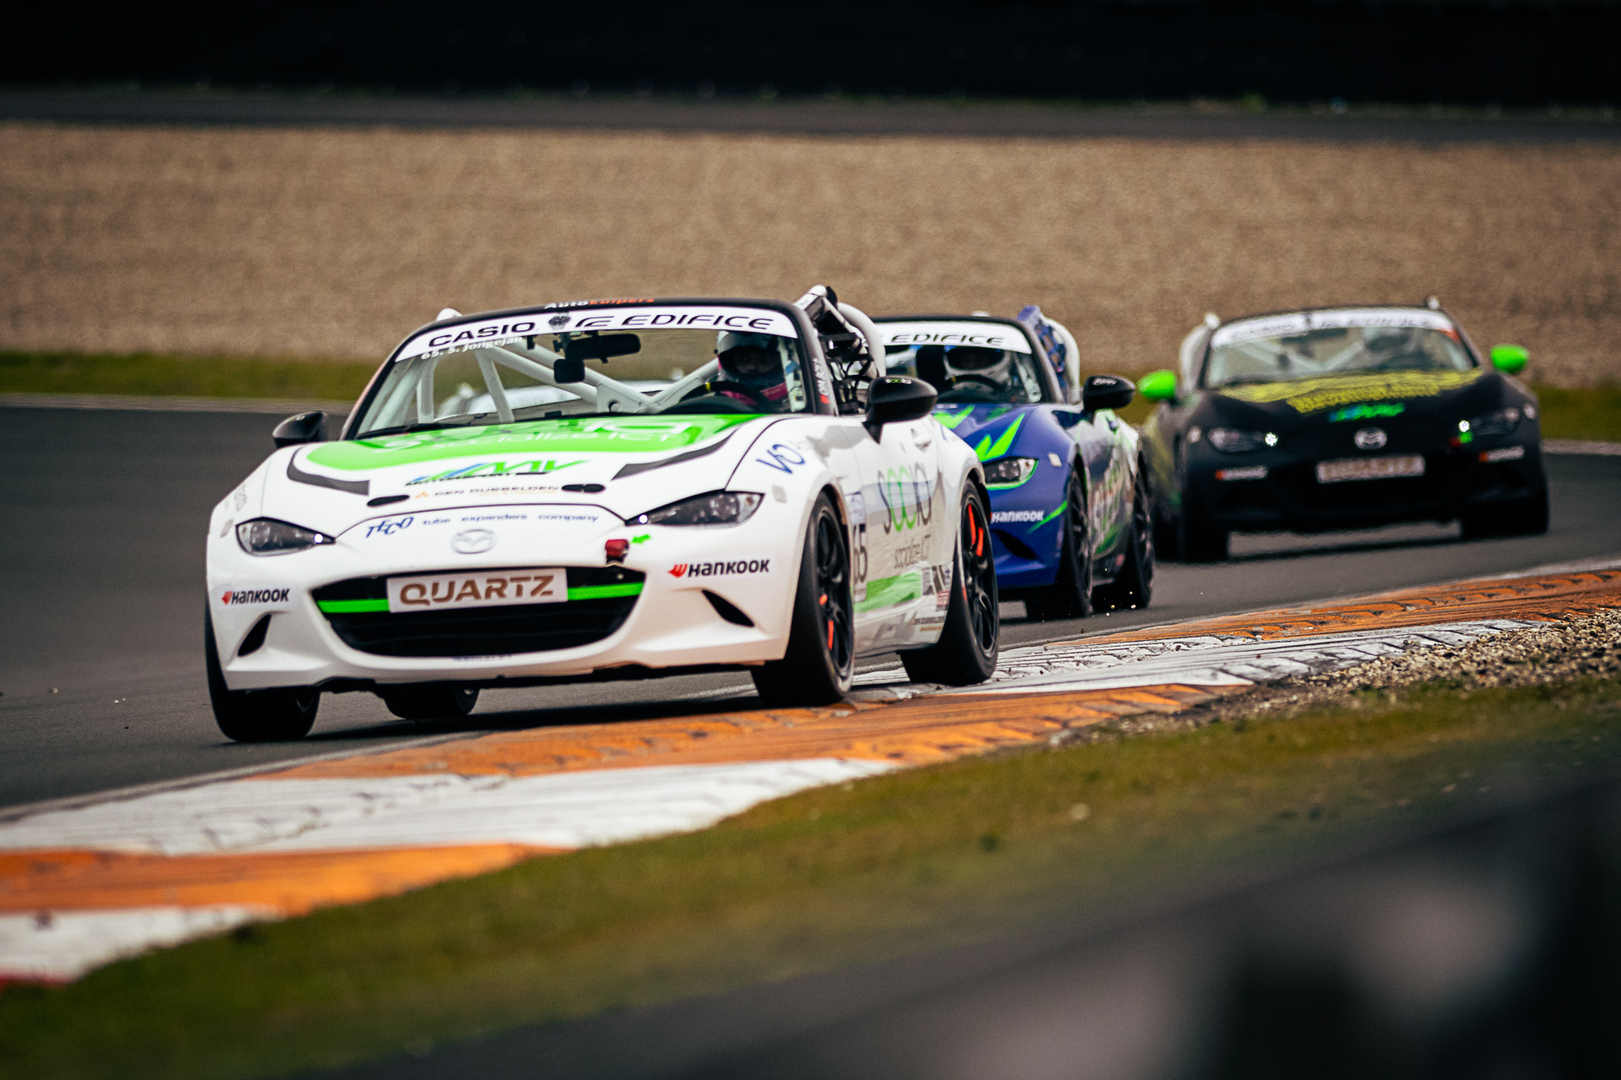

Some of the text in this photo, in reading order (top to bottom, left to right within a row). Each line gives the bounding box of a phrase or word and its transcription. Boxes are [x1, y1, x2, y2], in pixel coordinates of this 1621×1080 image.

[428, 314, 774, 347] CASIO EDIFICE
[890, 334, 1005, 346] EDIFICE
[422, 517, 452, 526] tube
[460, 513, 529, 523] expanders
[537, 514, 600, 523] company
[400, 575, 554, 607] QUARTZ
